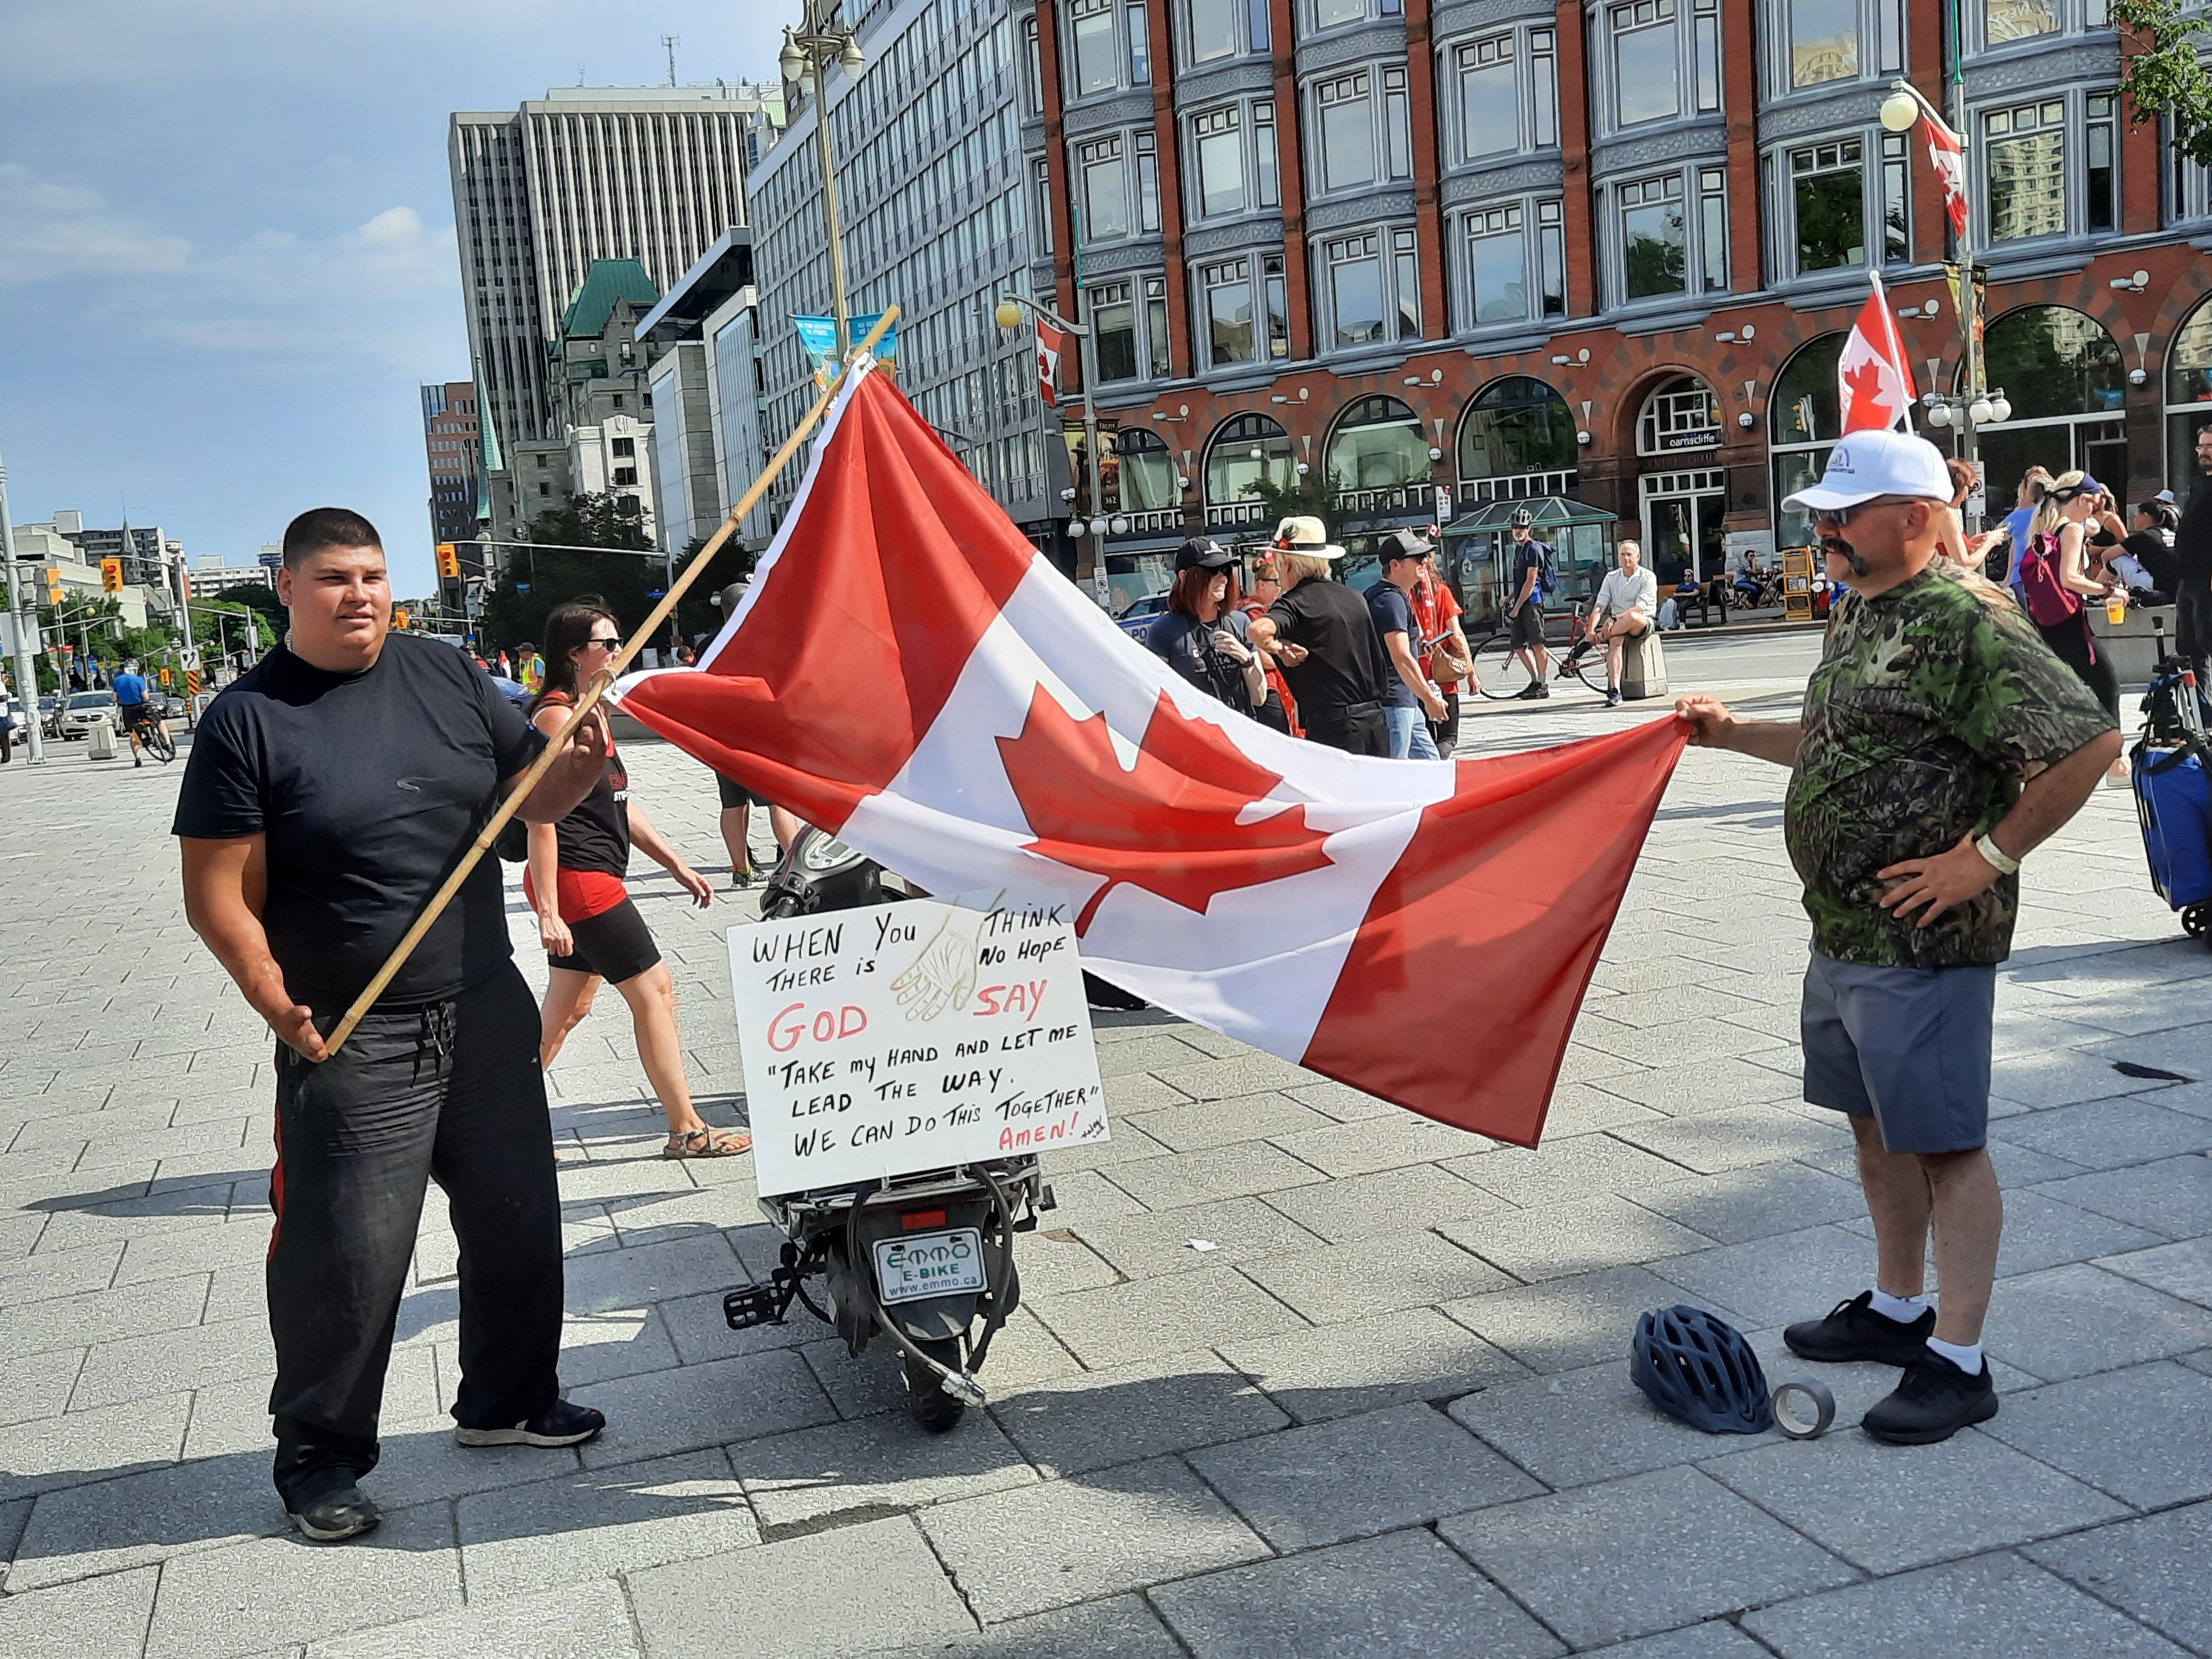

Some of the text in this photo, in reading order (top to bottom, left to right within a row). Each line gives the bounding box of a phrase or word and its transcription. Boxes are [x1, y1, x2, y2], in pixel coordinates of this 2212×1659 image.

[753, 923, 843, 963] WHEN
[765, 964, 836, 992] THERE
[979, 946, 1006, 966] NO
[768, 979, 1049, 1052] GOD SAY
[888, 1047, 938, 1067] HAND
[955, 1040, 989, 1057] AND
[1001, 1028, 1044, 1051] LET
[791, 1093, 852, 1118] LEAD
[874, 1080, 917, 1101] THE
[795, 1128, 836, 1157] WE
[851, 1119, 893, 1147] CAN
[905, 1116, 936, 1136] DO
[889, 1276, 977, 1296] www.emmo.ca
[903, 1263, 961, 1281] E-BIKE
